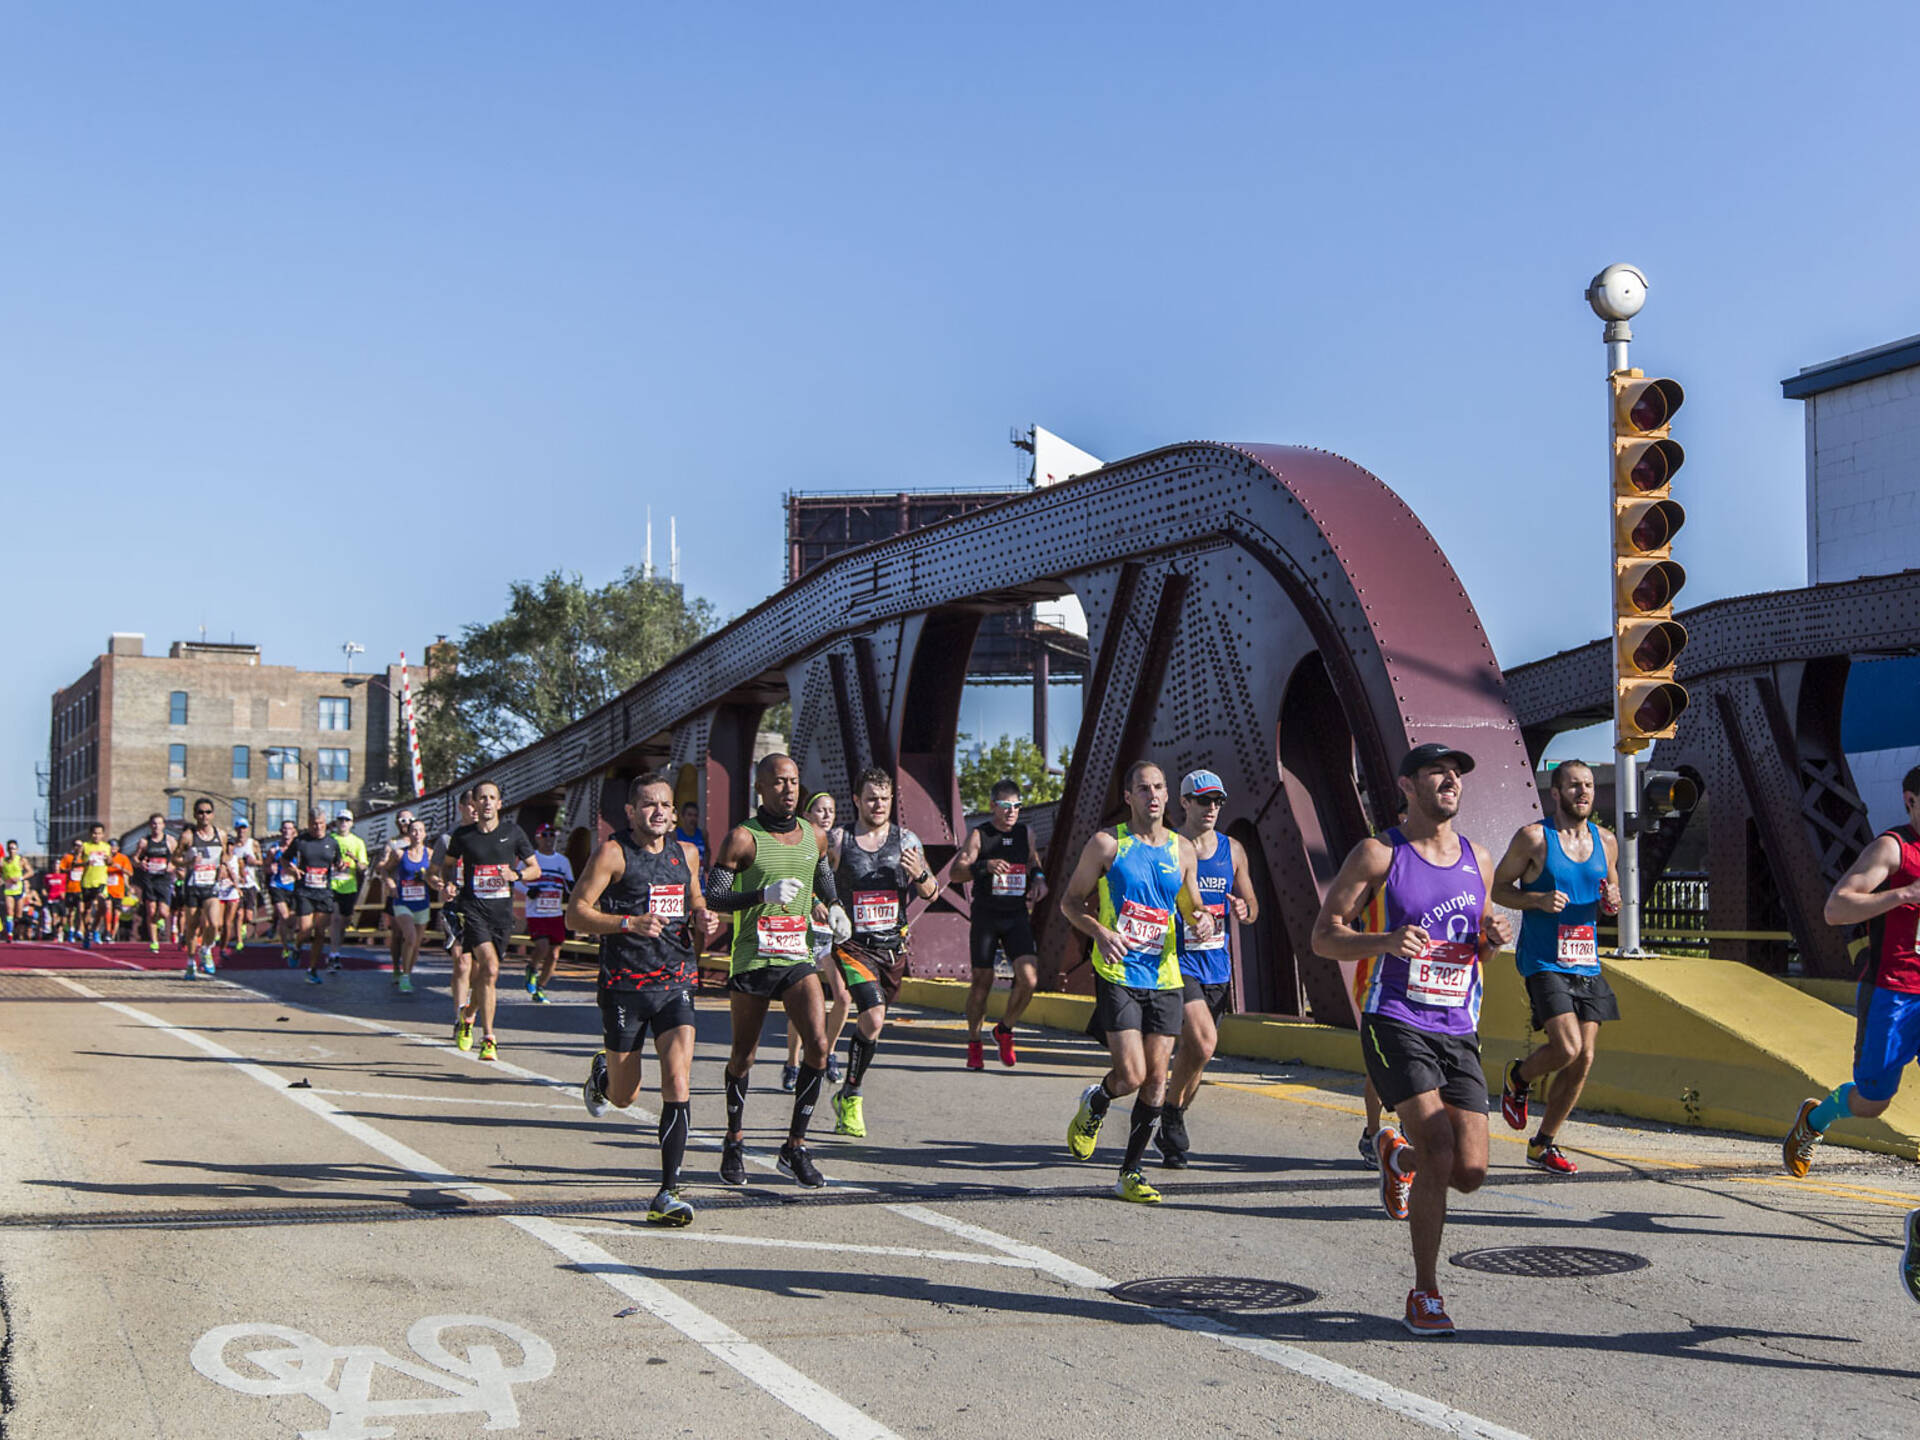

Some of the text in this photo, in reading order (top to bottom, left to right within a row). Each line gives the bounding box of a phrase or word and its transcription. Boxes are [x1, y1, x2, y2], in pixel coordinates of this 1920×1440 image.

[1200, 877, 1227, 889] NBR
[650, 898, 684, 914] B 2321
[857, 905, 894, 920] B 11071
[1433, 890, 1477, 921] purple
[1123, 919, 1161, 940] A 3130
[1420, 964, 1467, 987] B 7027
